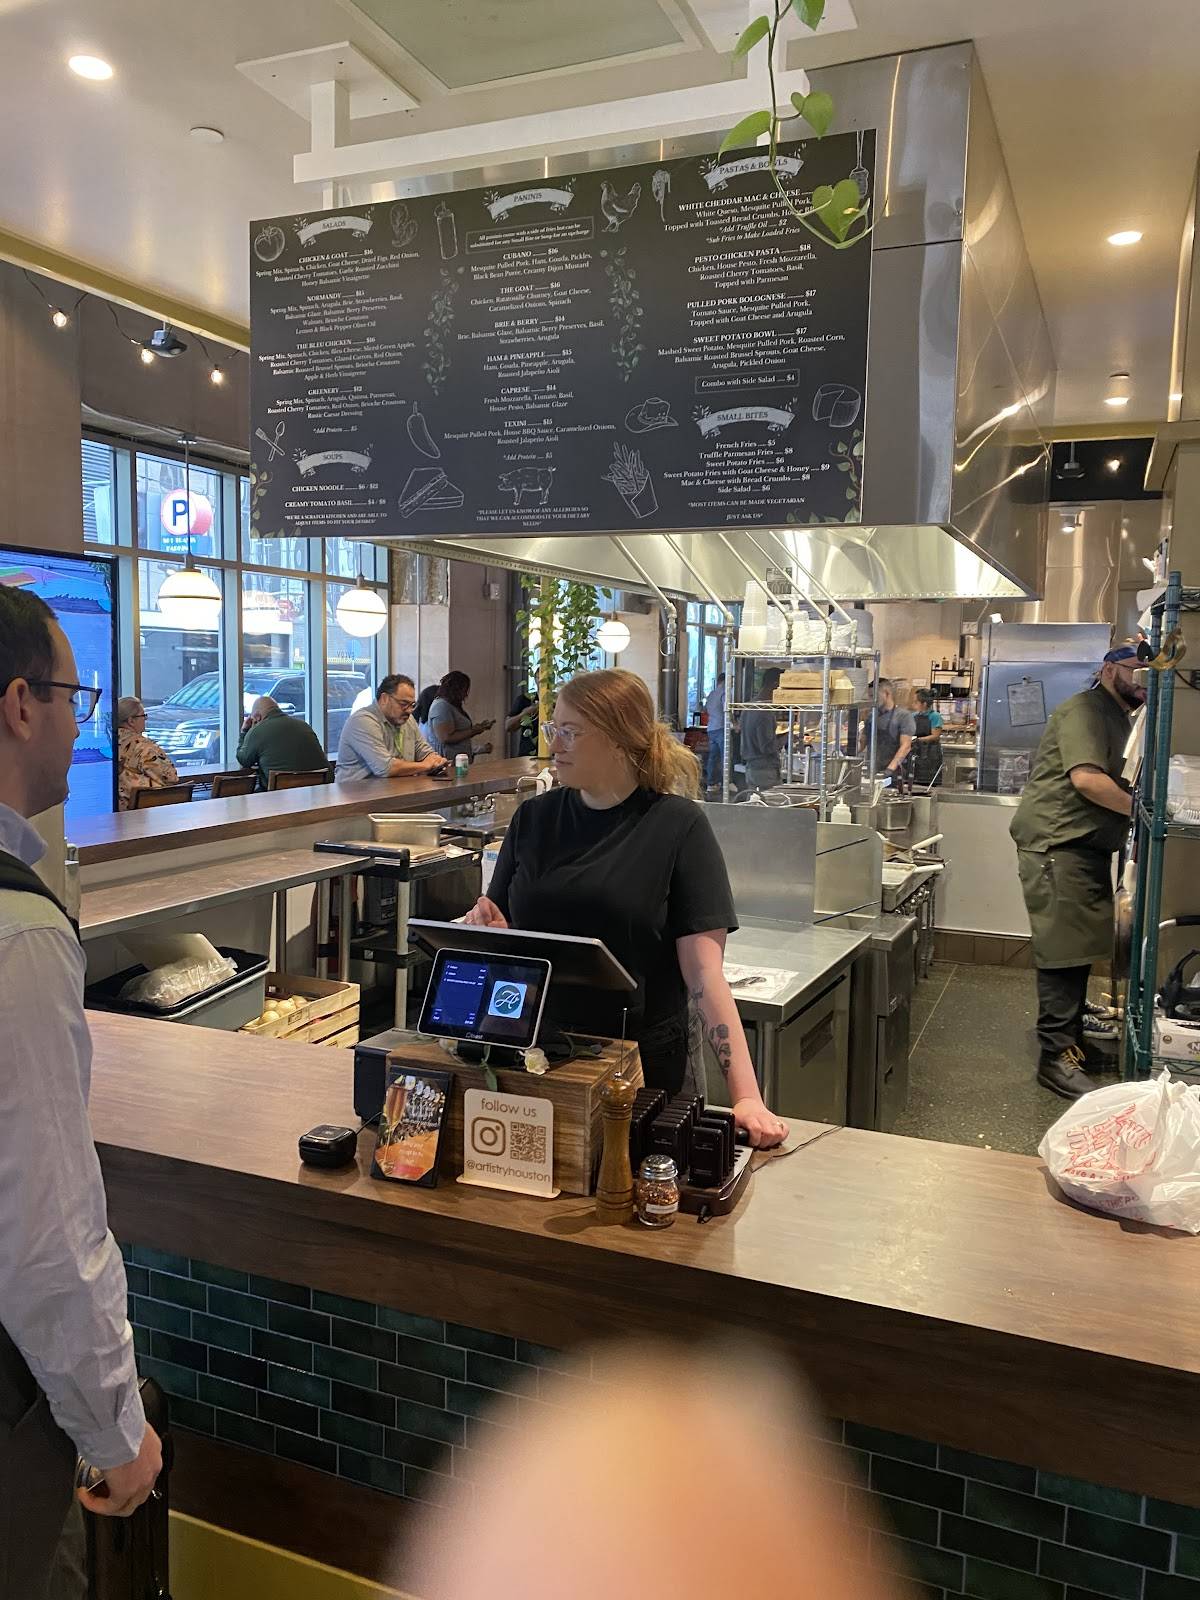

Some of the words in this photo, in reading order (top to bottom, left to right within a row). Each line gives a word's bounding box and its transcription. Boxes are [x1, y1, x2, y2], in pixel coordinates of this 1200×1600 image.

[679, 201, 704, 210] WHITE
[706, 196, 742, 206] CHEDDAR
[503, 251, 531, 259] CUBANO
[694, 254, 718, 262] PESTO
[719, 250, 754, 260] CHICKEN
[756, 248, 779, 256] PASTA
[688, 264, 715, 273] Chicken,
[738, 259, 757, 267] Pesto,
[699, 272, 724, 280] Roasted
[726, 269, 748, 278] Cherry
[749, 266, 785, 275] Tomatoes,
[714, 280, 738, 289] Topped
[756, 275, 788, 283] Parmesan
[717, 297, 737, 305] PORK
[739, 293, 785, 303] BOLOGNESE
[689, 318, 713, 326] Topped
[786, 309, 812, 318] Arugula
[720, 332, 751, 340] POTATO
[726, 341, 755, 350] Mesquite
[510, 351, 544, 359] PINEAPPLE
[786, 465, 809, 473] Honey
[172, 500, 188, 526] P
[481, 1098, 520, 1114] follow
[523, 1107, 537, 1118] us
[466, 1159, 551, 1182] @artistryhouston
